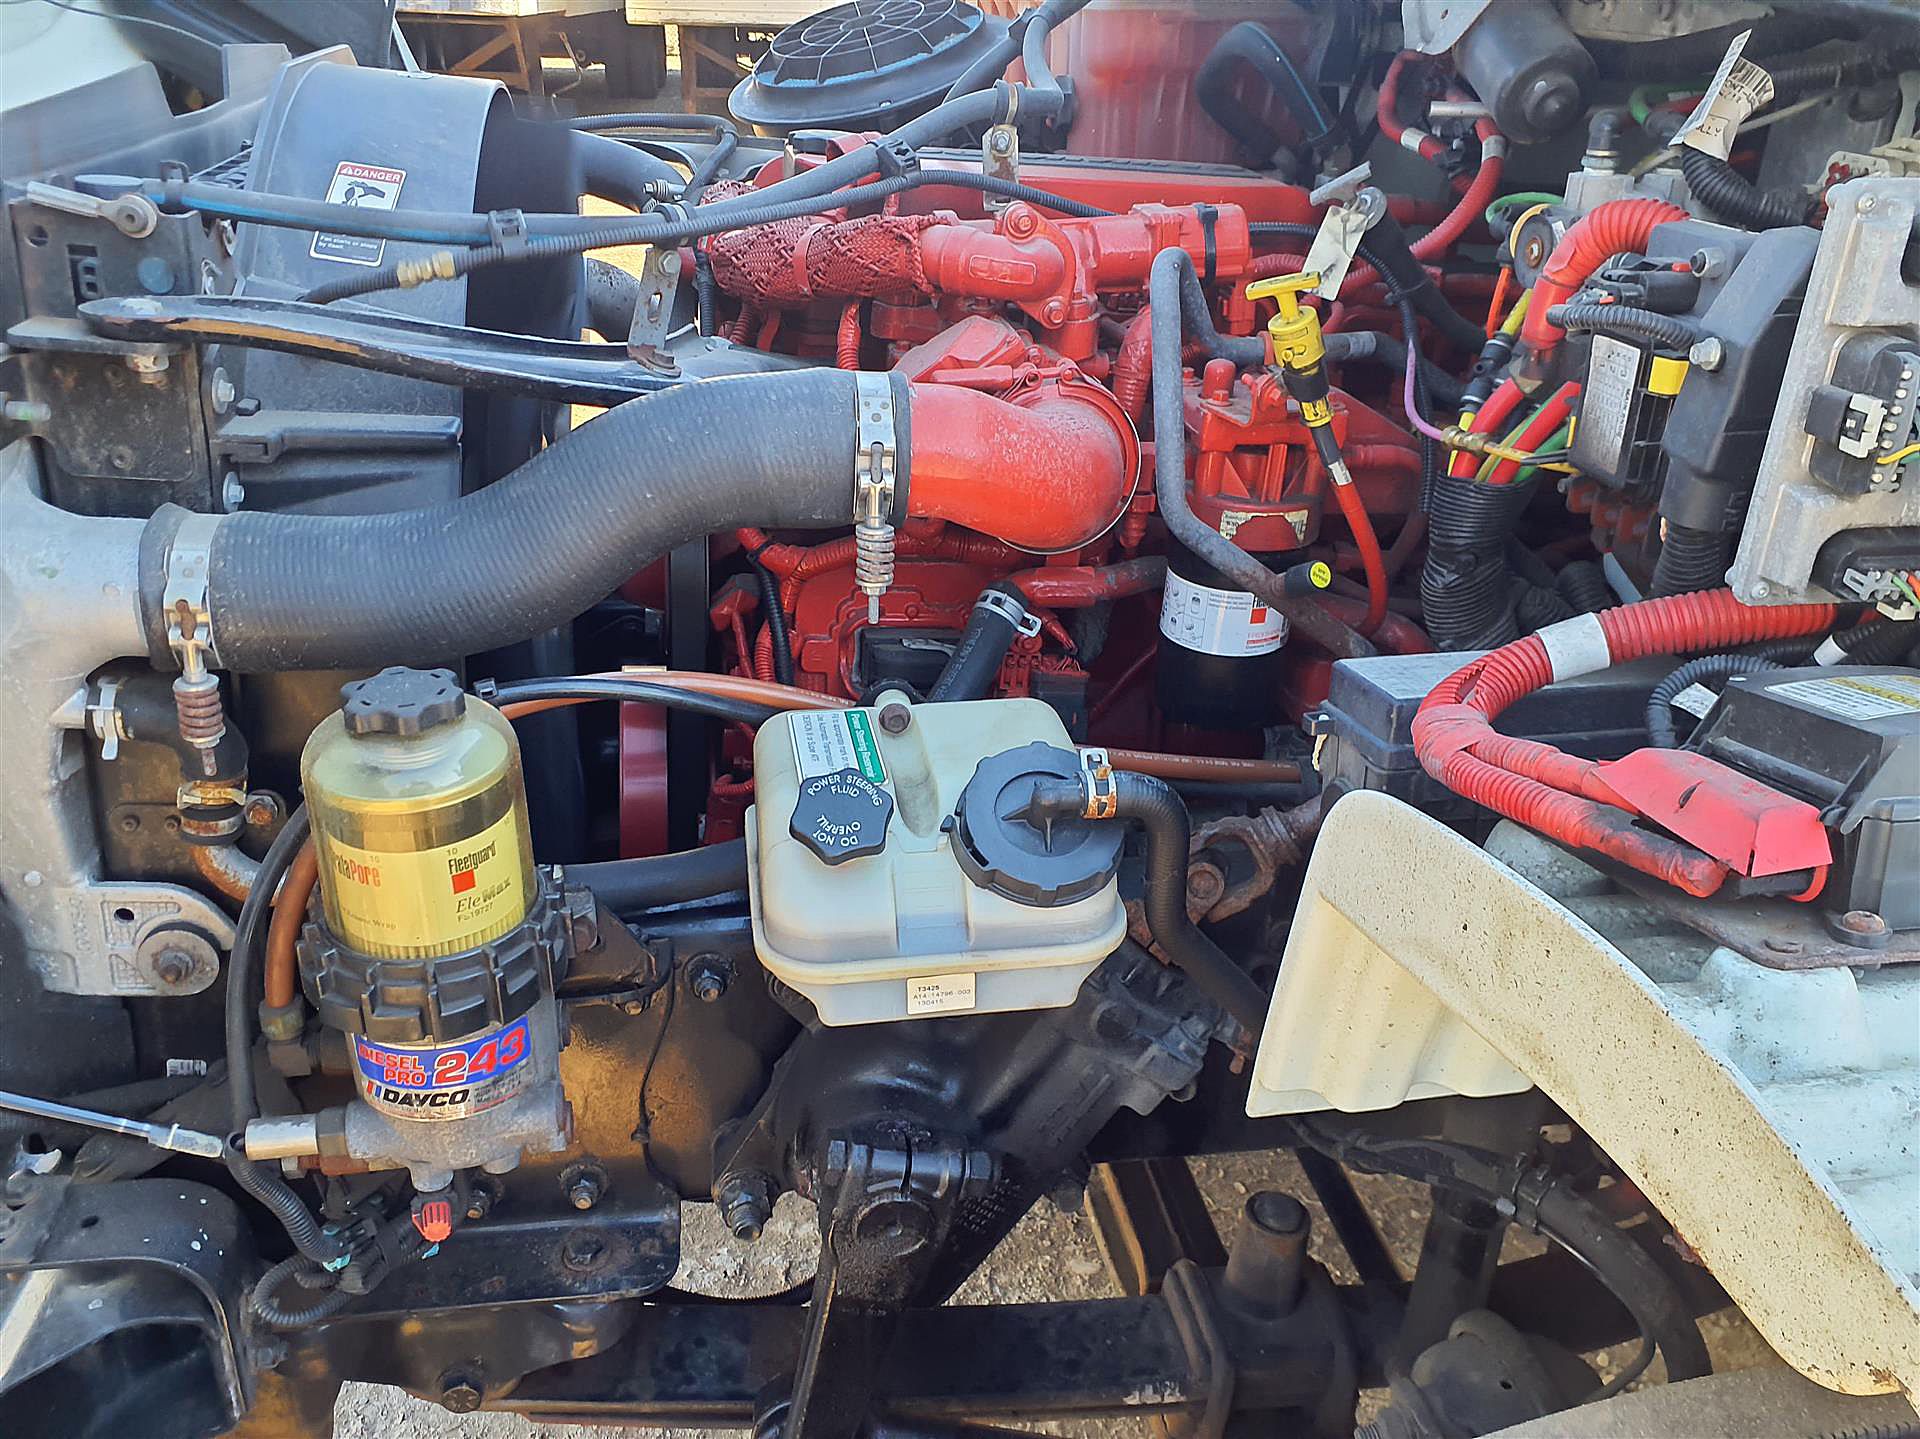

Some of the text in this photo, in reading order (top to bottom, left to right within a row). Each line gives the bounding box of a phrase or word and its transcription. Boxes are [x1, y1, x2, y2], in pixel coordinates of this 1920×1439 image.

[353, 168, 401, 182] DANGER
[807, 774, 883, 806] POWER STEERING
[831, 784, 860, 798] FLUID
[816, 814, 861, 836] OVERFILL
[813, 830, 858, 847] DO NOT
[447, 840, 497, 875] Fleetguard
[358, 1042, 425, 1072] DIESEL
[432, 1026, 527, 1087] 243
[383, 1067, 427, 1087] PRO
[383, 1088, 470, 1108] DAYCO
